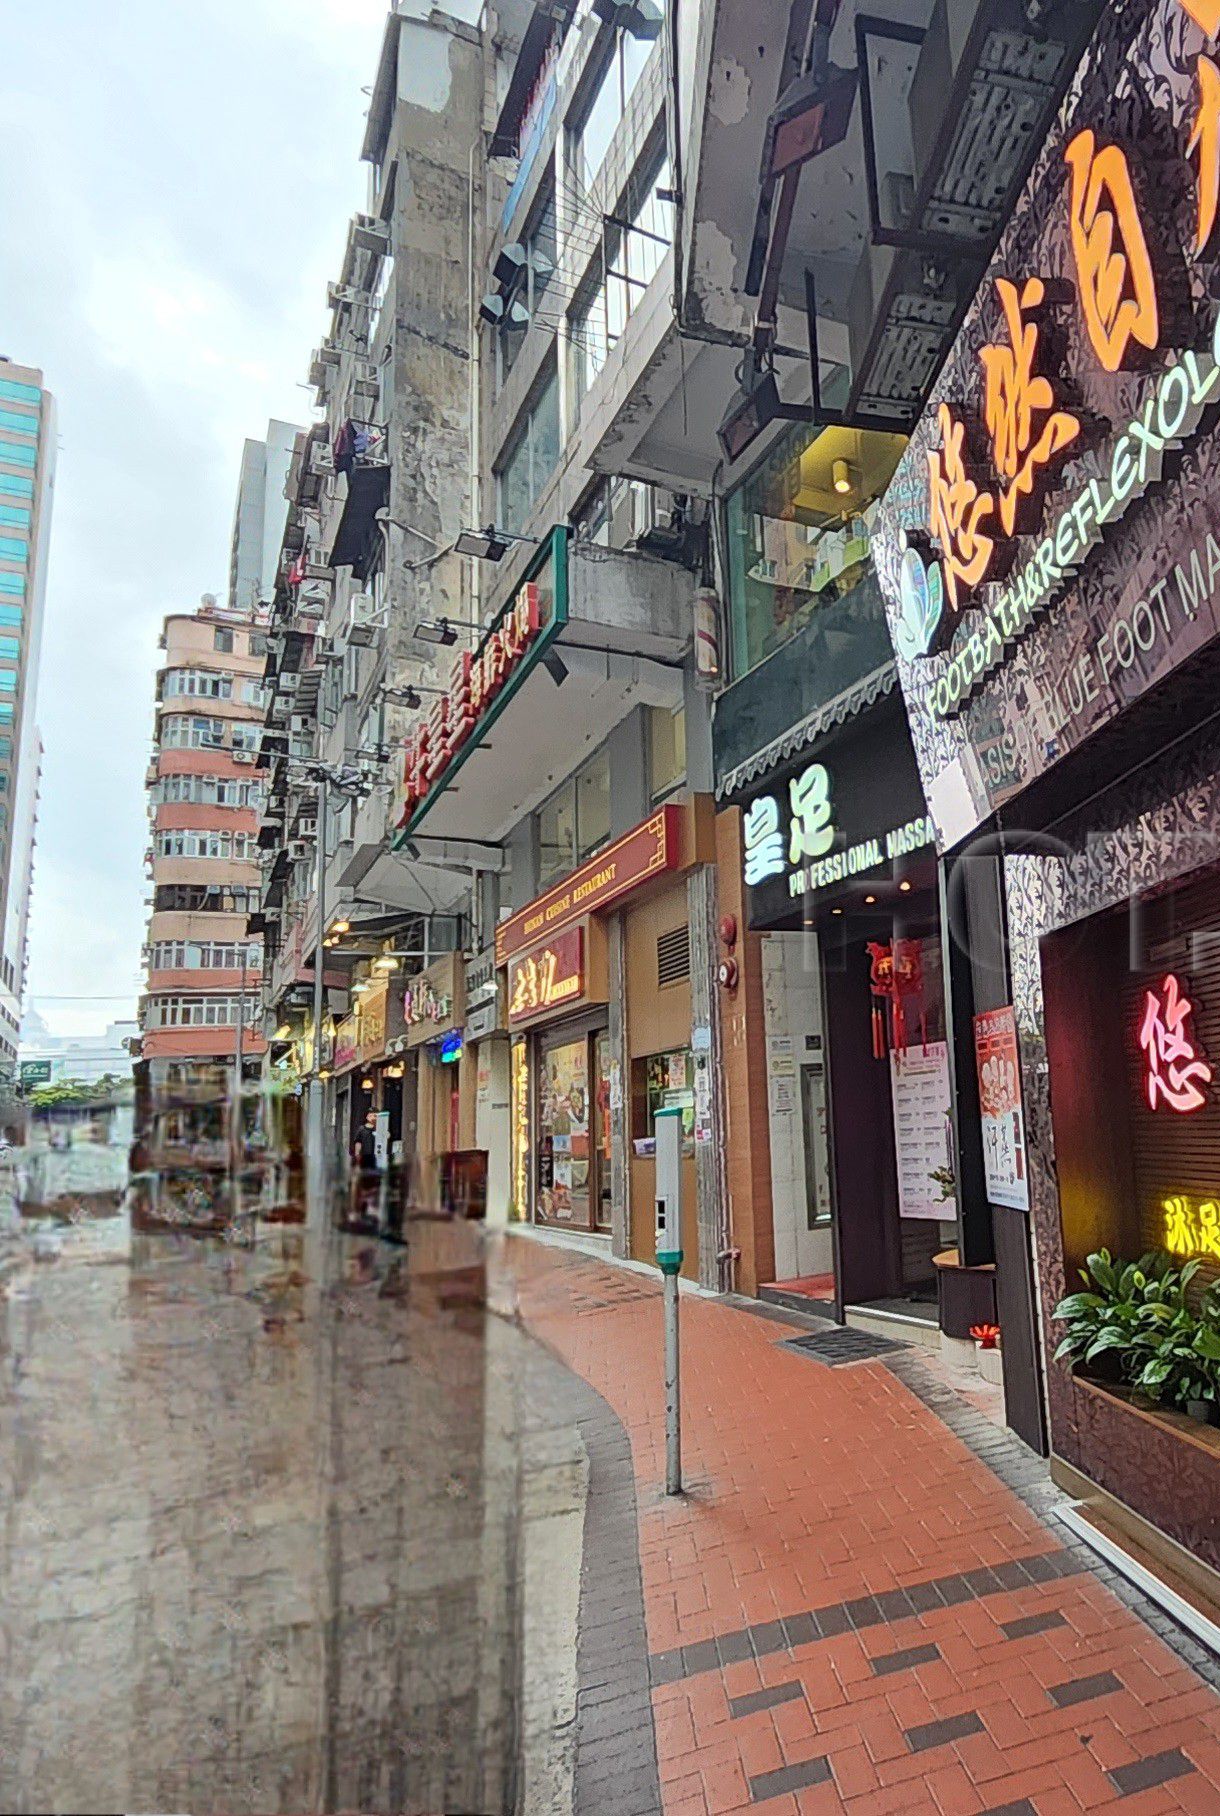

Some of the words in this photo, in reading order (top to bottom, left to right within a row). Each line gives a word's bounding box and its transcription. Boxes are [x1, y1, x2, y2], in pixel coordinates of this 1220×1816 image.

[1097, 578, 1170, 684] FOOT
[744, 764, 835, 886] 皇足
[789, 838, 884, 898] PRFESSIONAL
